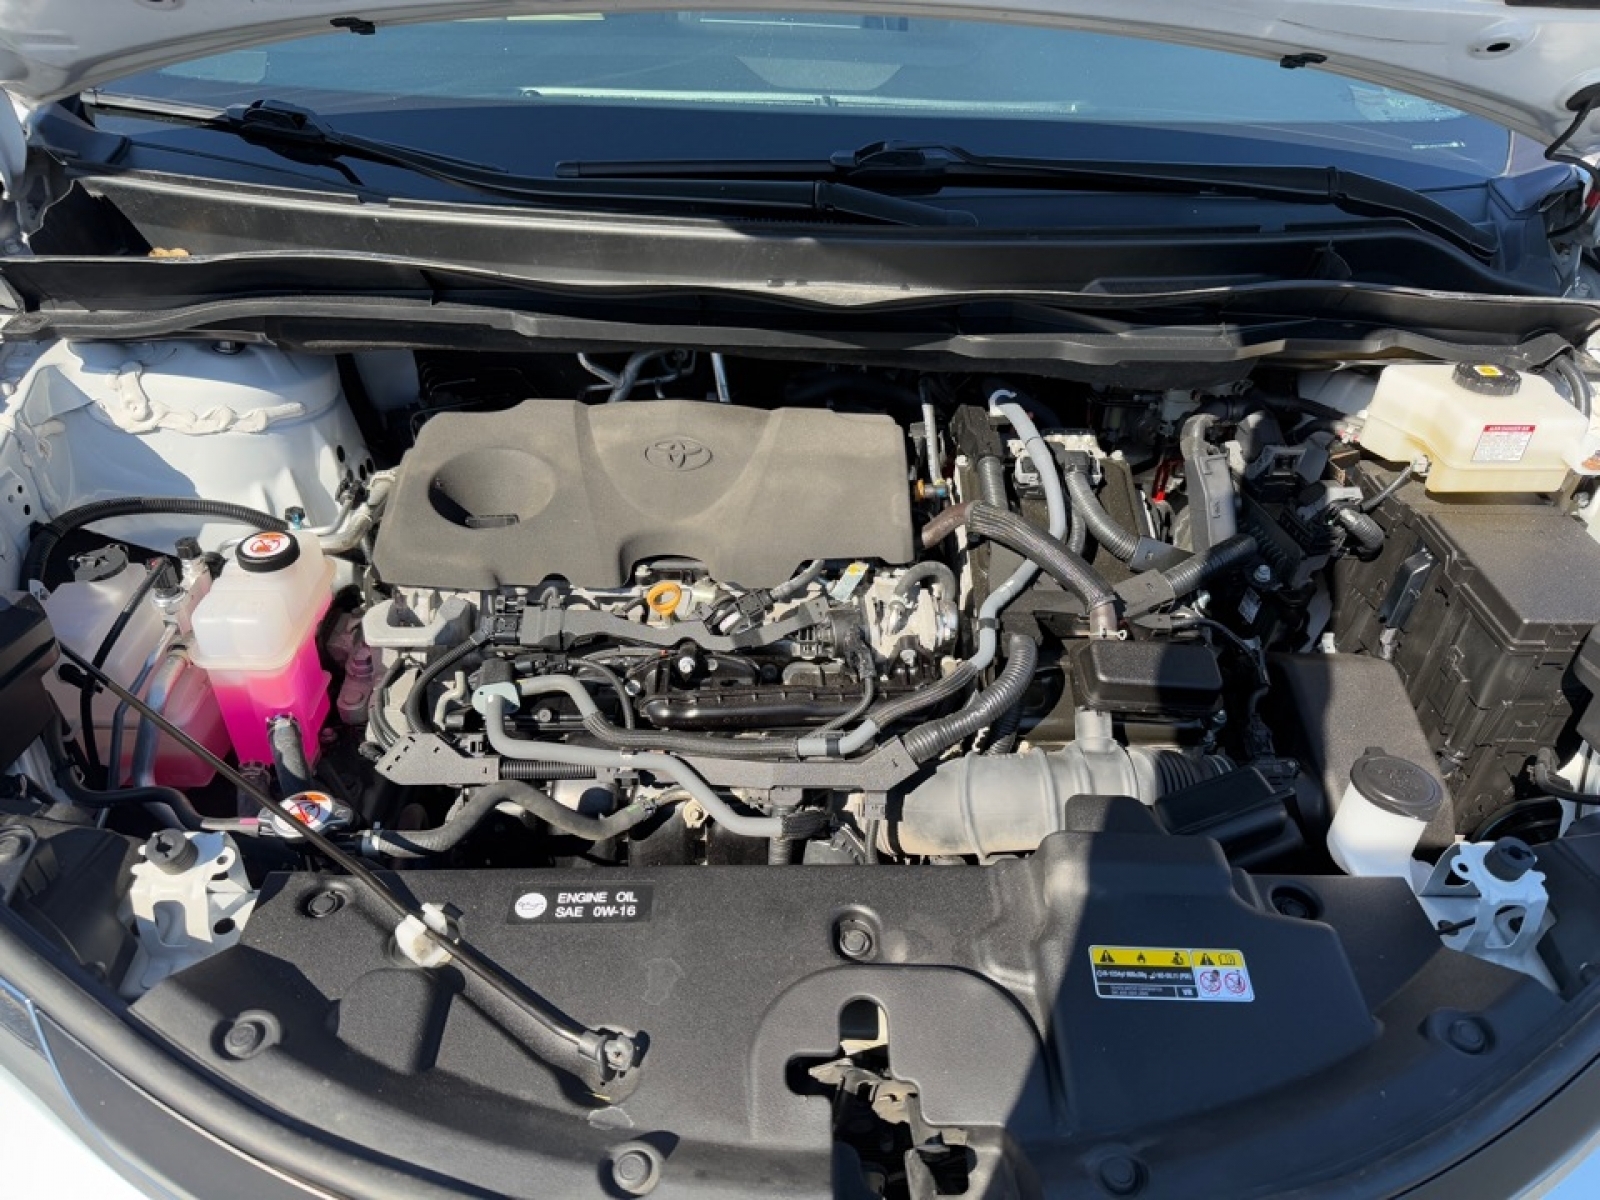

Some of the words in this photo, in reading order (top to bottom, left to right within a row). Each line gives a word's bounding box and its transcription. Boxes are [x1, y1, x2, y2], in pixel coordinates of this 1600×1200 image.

[557, 891, 608, 904] ENGINE
[615, 891, 638, 903] OIL
[554, 906, 584, 918] SAE
[592, 905, 636, 917] 0W-16
